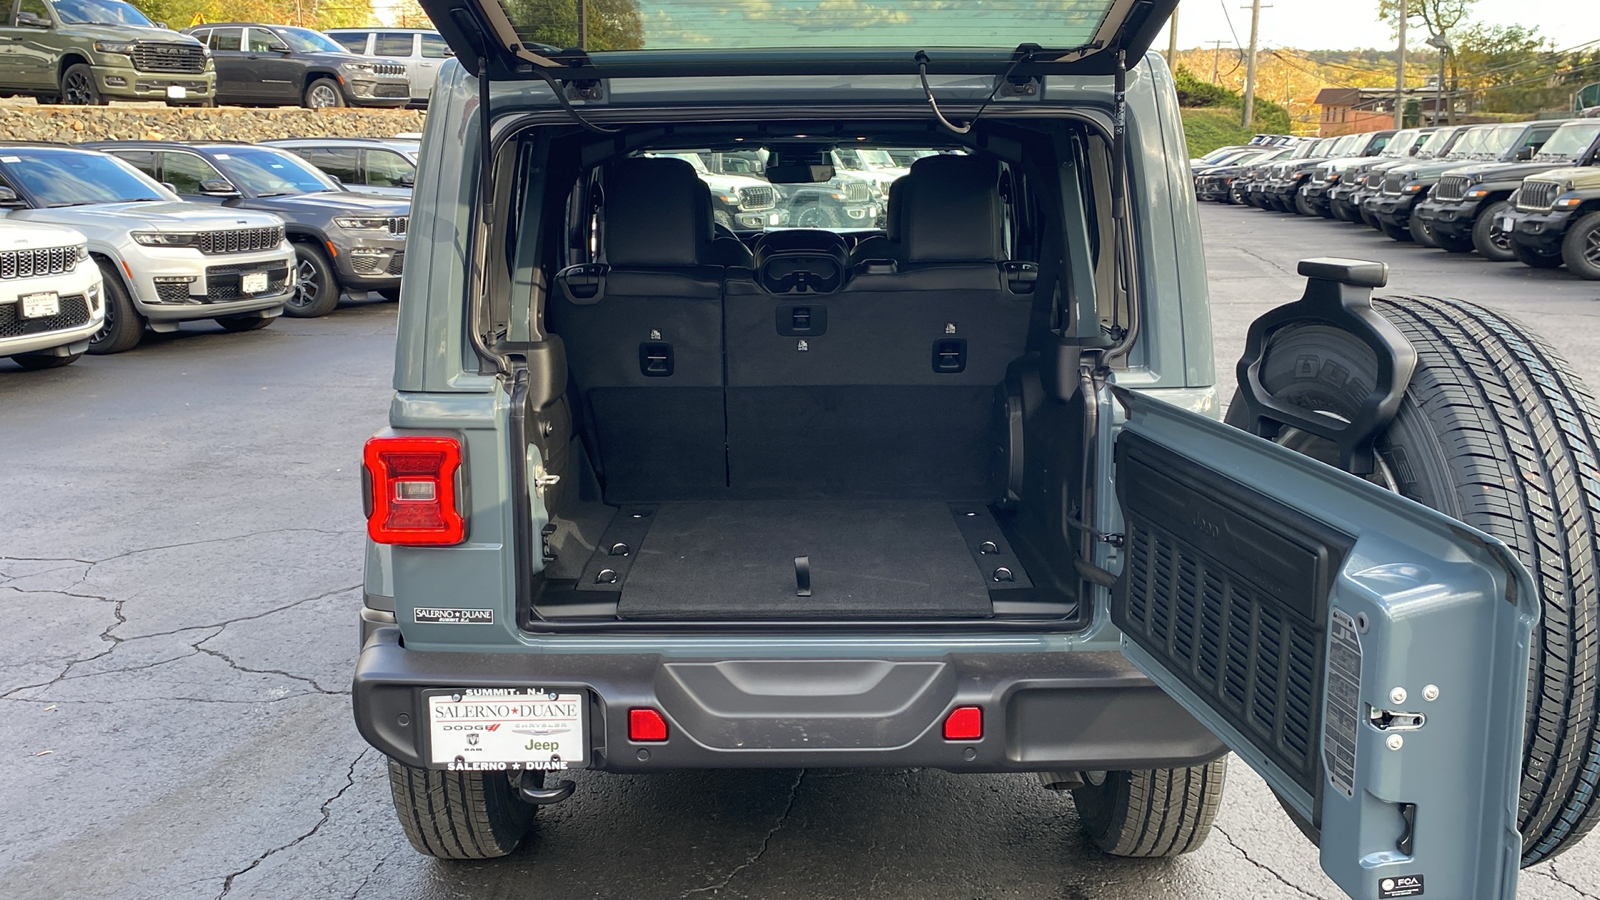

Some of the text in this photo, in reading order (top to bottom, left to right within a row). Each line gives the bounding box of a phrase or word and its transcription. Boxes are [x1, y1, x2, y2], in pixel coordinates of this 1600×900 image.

[416, 609, 492, 619] SALERNO DUANE
[1331, 626, 1358, 646] JL
[527, 688, 544, 696] NJ
[435, 704, 578, 719] SALERNO DUANE
[443, 724, 494, 732] DODGE
[524, 739, 560, 753] Jeep
[447, 761, 569, 771] SALERNO DUANE
[1397, 876, 1419, 886] FCA
